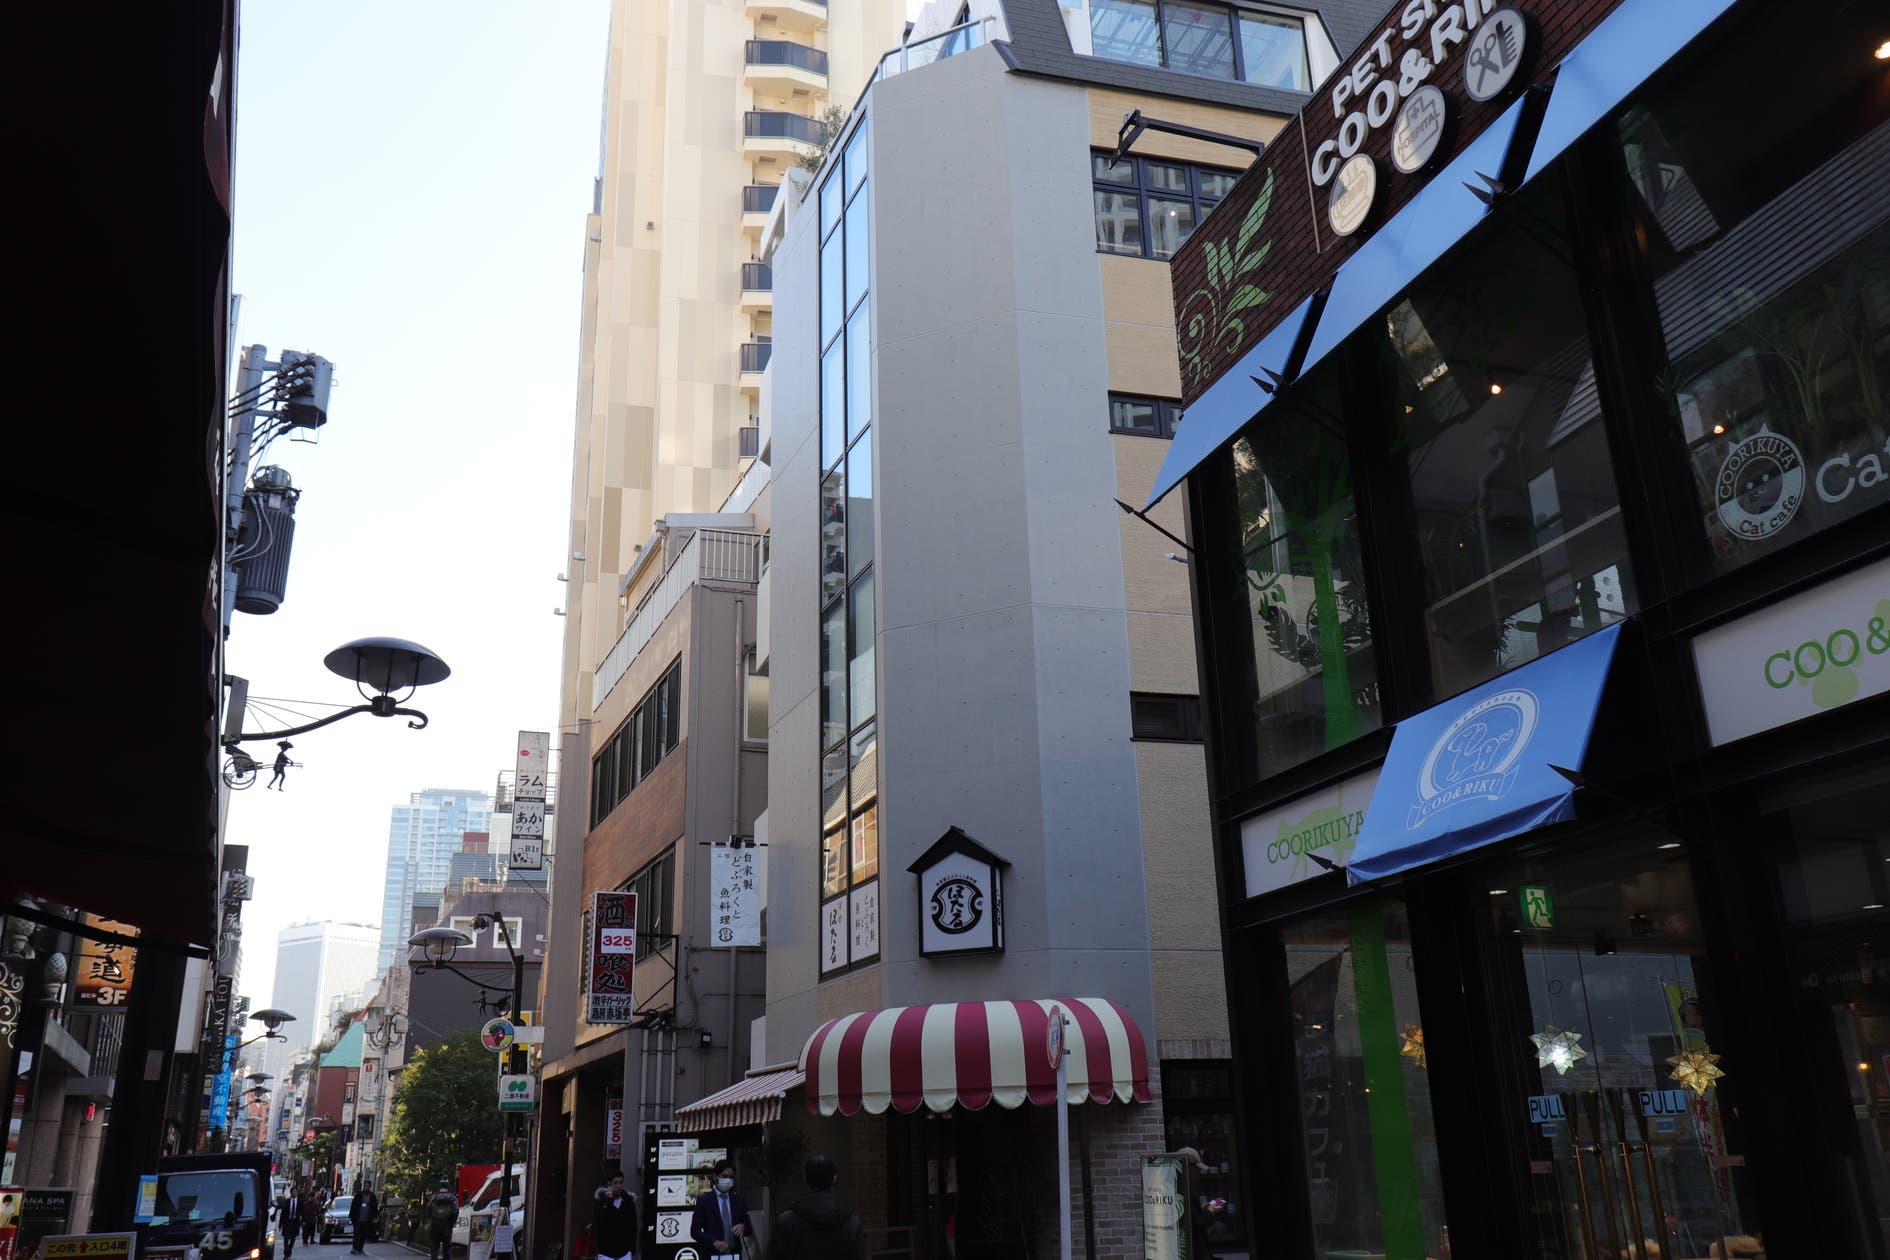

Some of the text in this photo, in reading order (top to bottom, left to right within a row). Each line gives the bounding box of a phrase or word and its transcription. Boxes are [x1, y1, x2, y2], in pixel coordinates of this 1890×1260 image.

[1332, 28, 1396, 119] PET
[1311, 0, 1497, 186] COO&RI
[1397, 109, 1441, 156] HOSPITAL
[1719, 437, 1797, 499] COORIKUYA
[1815, 452, 1890, 503] Ca
[1741, 494, 1797, 537] Cat cafe
[518, 775, 544, 787] ラム
[1421, 778, 1503, 816] COO&RIKU
[515, 811, 542, 825] あか
[731, 856, 745, 919] どぶろくと
[743, 852, 753, 890] 自家製
[719, 888, 731, 925] 魚料理
[948, 884, 964, 928] ほたる
[602, 935, 633, 947] 325
[97, 986, 127, 1005] 3F
[1530, 1097, 1567, 1121] PULL
[1641, 1091, 1686, 1115] PULL
[611, 1111, 622, 1143] 325
[48, 1240, 128, 1254] この先 入口4階
[199, 1231, 234, 1251] 45
